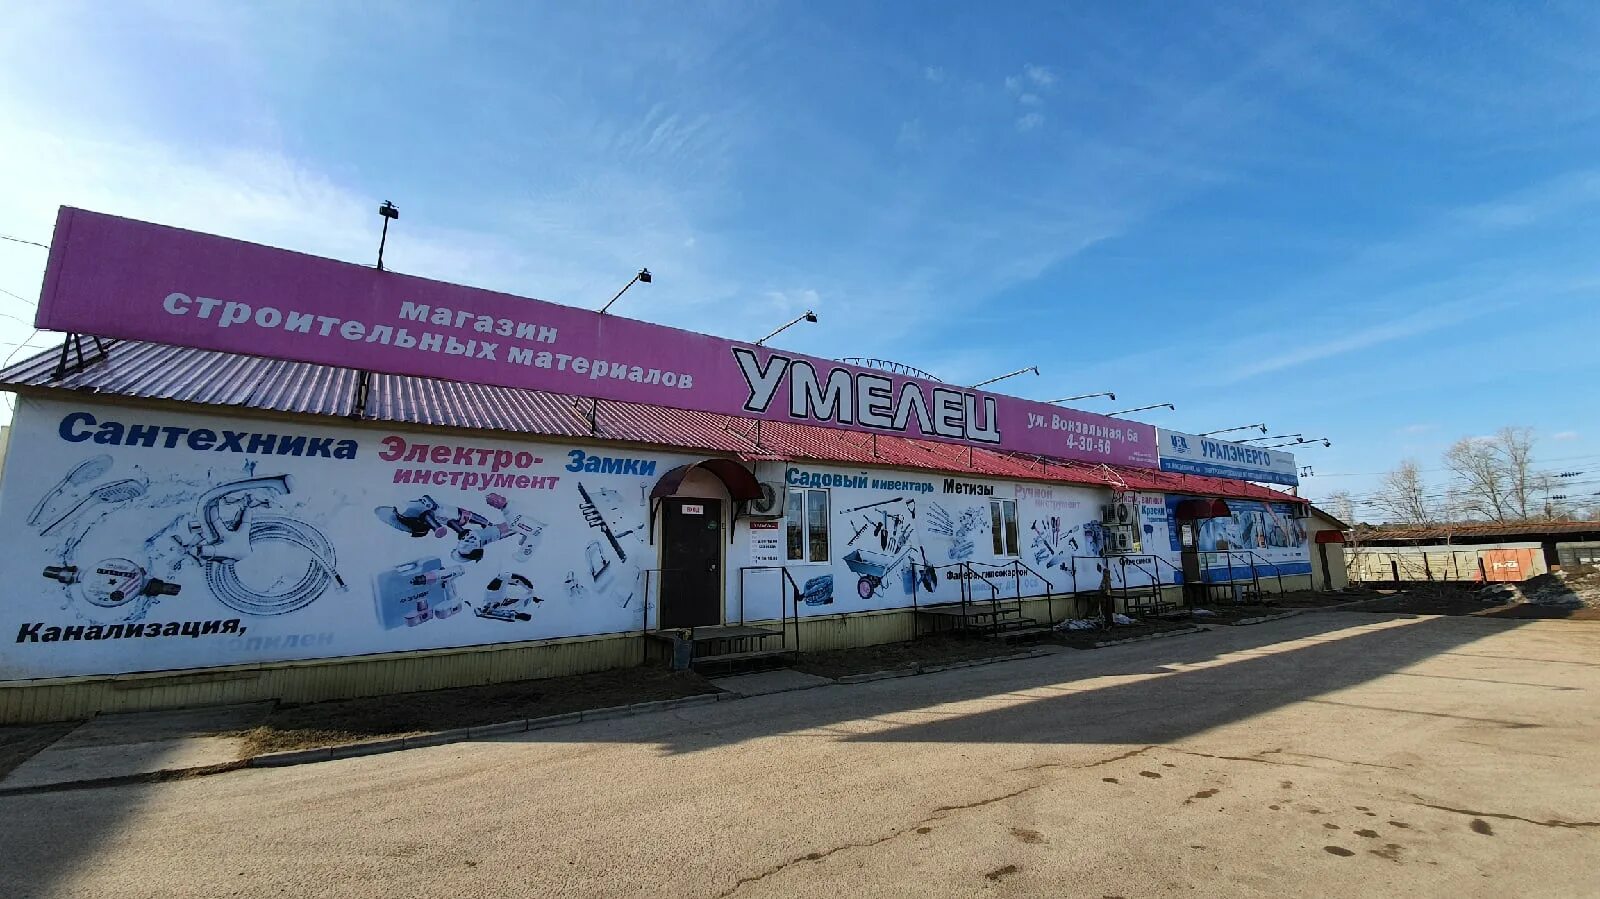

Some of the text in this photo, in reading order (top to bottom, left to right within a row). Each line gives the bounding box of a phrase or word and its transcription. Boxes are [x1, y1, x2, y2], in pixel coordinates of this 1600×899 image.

[399, 301, 558, 344] магазин
[163, 292, 693, 389] строительных материалов
[731, 347, 1001, 444] УМЕЛЕЦ
[58, 411, 359, 460] Сантехника
[1027, 412, 1047, 429] ул.
[1127, 428, 1138, 443] 6а
[378, 435, 544, 472] Электро-
[1066, 433, 1111, 455] 4-30-56
[1200, 439, 1271, 466] УРАЛЭНЕРГО
[564, 449, 657, 477] Замки
[393, 467, 560, 492] инструмент
[786, 467, 935, 495] Садовый инвентарь
[942, 478, 994, 496] Метизы
[1014, 483, 1053, 501] Ручной
[1141, 505, 1166, 516] Краски
[15, 618, 247, 643] Канализация,
